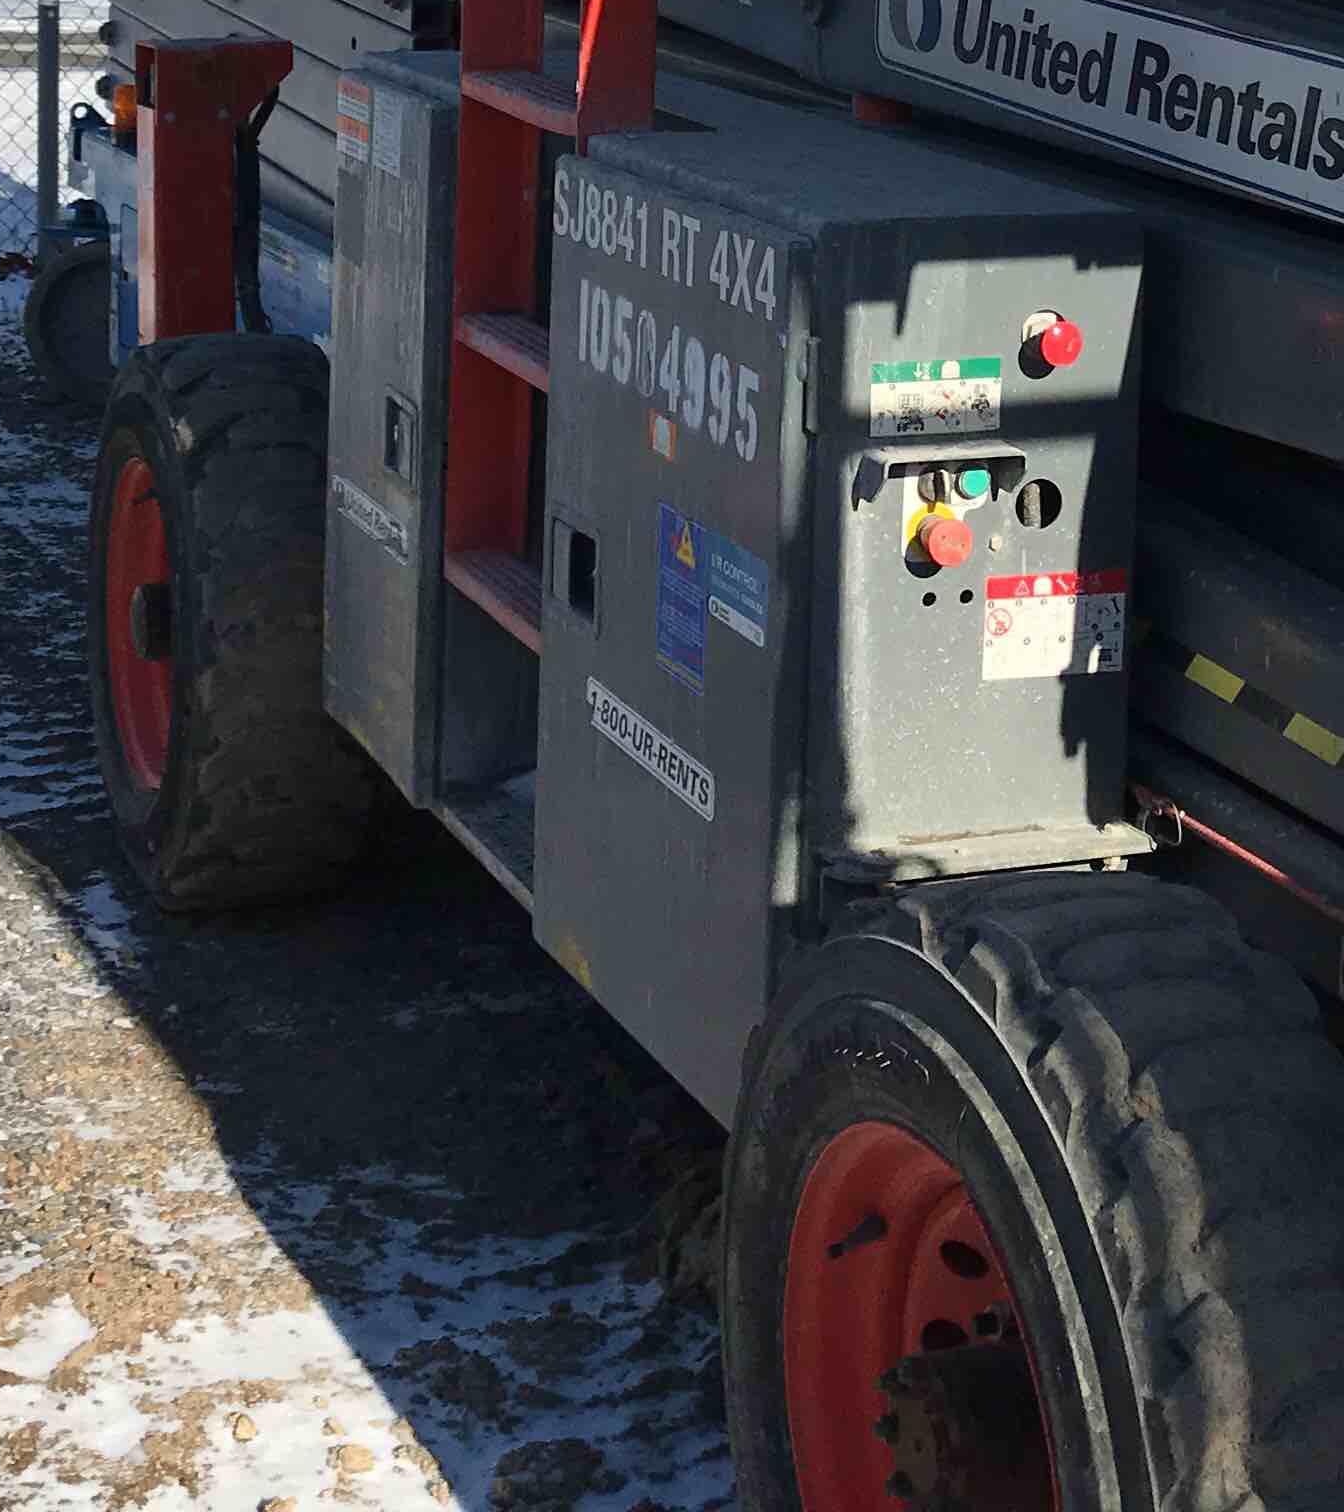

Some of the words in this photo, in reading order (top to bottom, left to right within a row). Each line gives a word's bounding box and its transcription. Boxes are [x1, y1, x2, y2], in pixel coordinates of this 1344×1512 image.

[553, 169, 649, 269] SJ8841
[660, 206, 701, 287] RT
[709, 229, 776, 321] 4X4
[591, 690, 710, 806] 1-800-UR-RENTS
